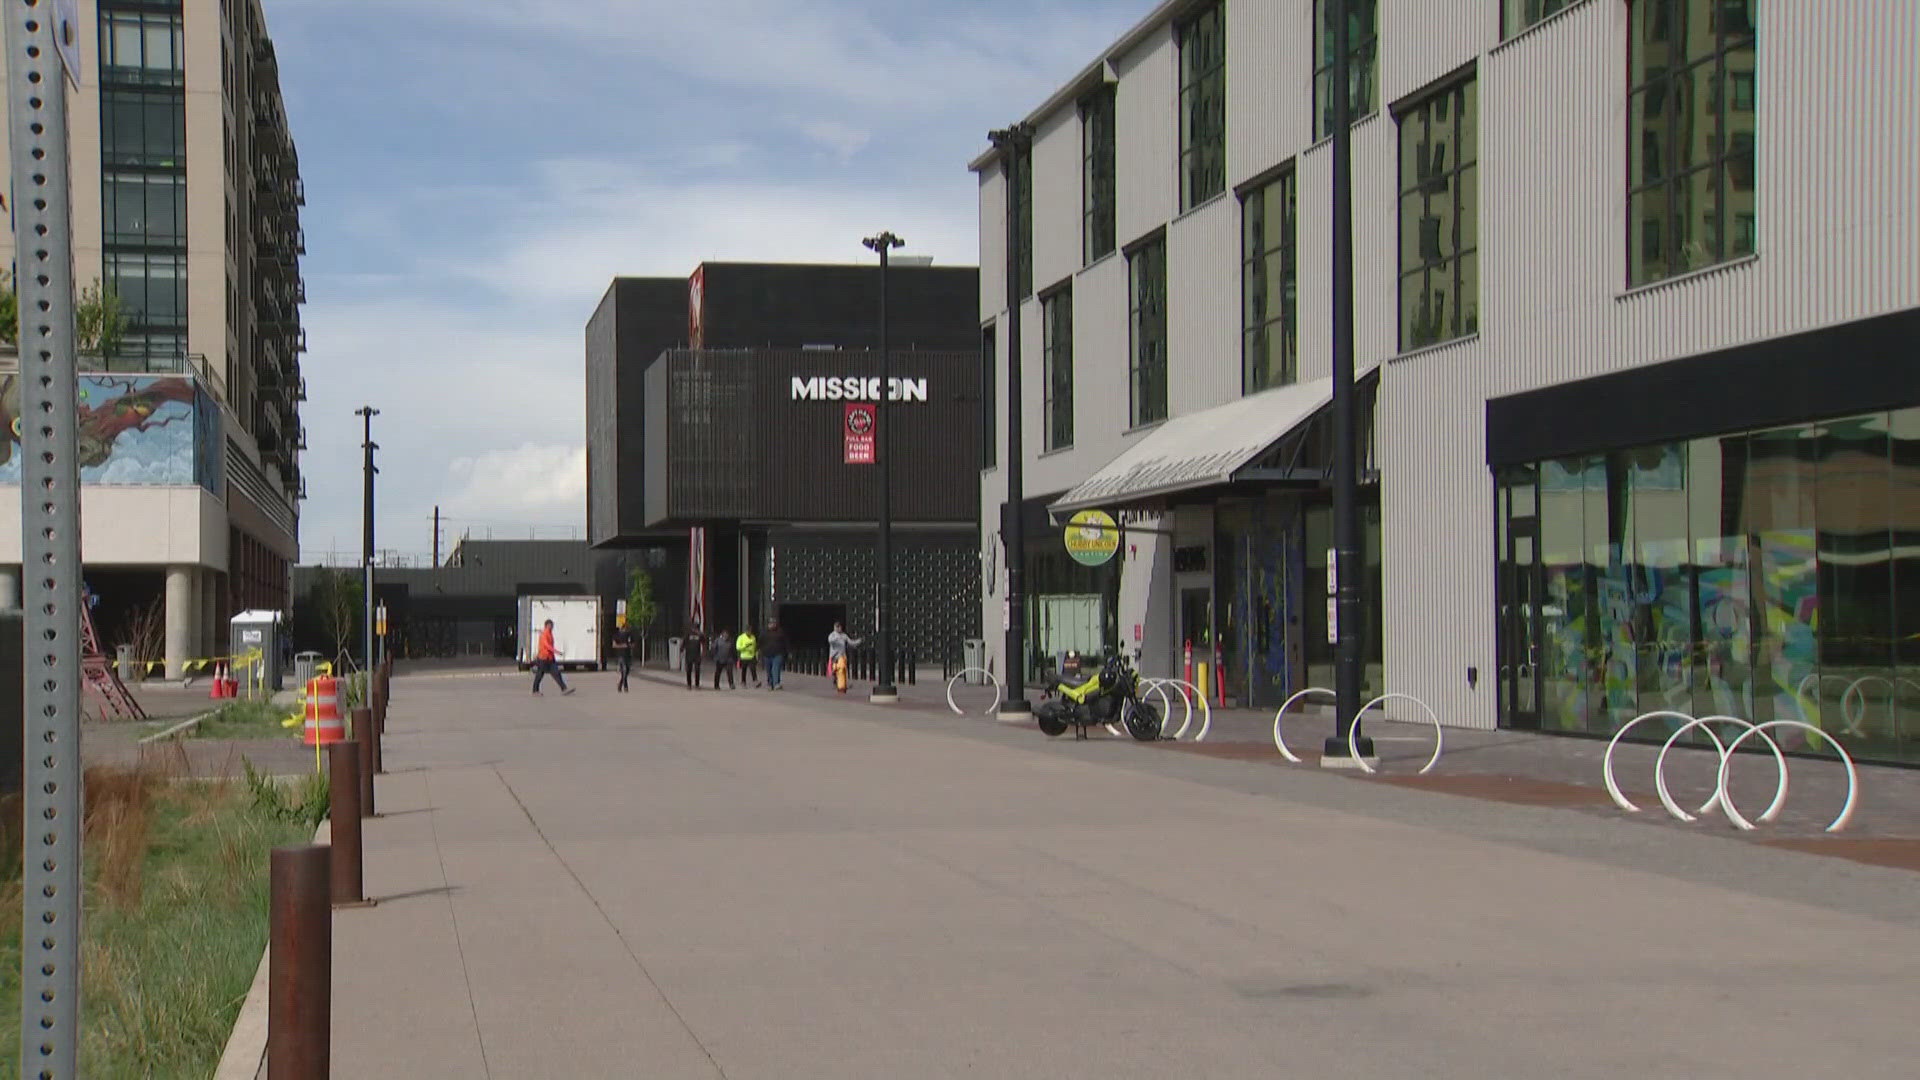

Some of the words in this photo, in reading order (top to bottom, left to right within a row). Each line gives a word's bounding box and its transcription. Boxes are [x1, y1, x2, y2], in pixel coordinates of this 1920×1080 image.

[791, 376, 927, 401] MISSION
[849, 443, 870, 451] FOOD
[849, 452, 869, 460] BEER
